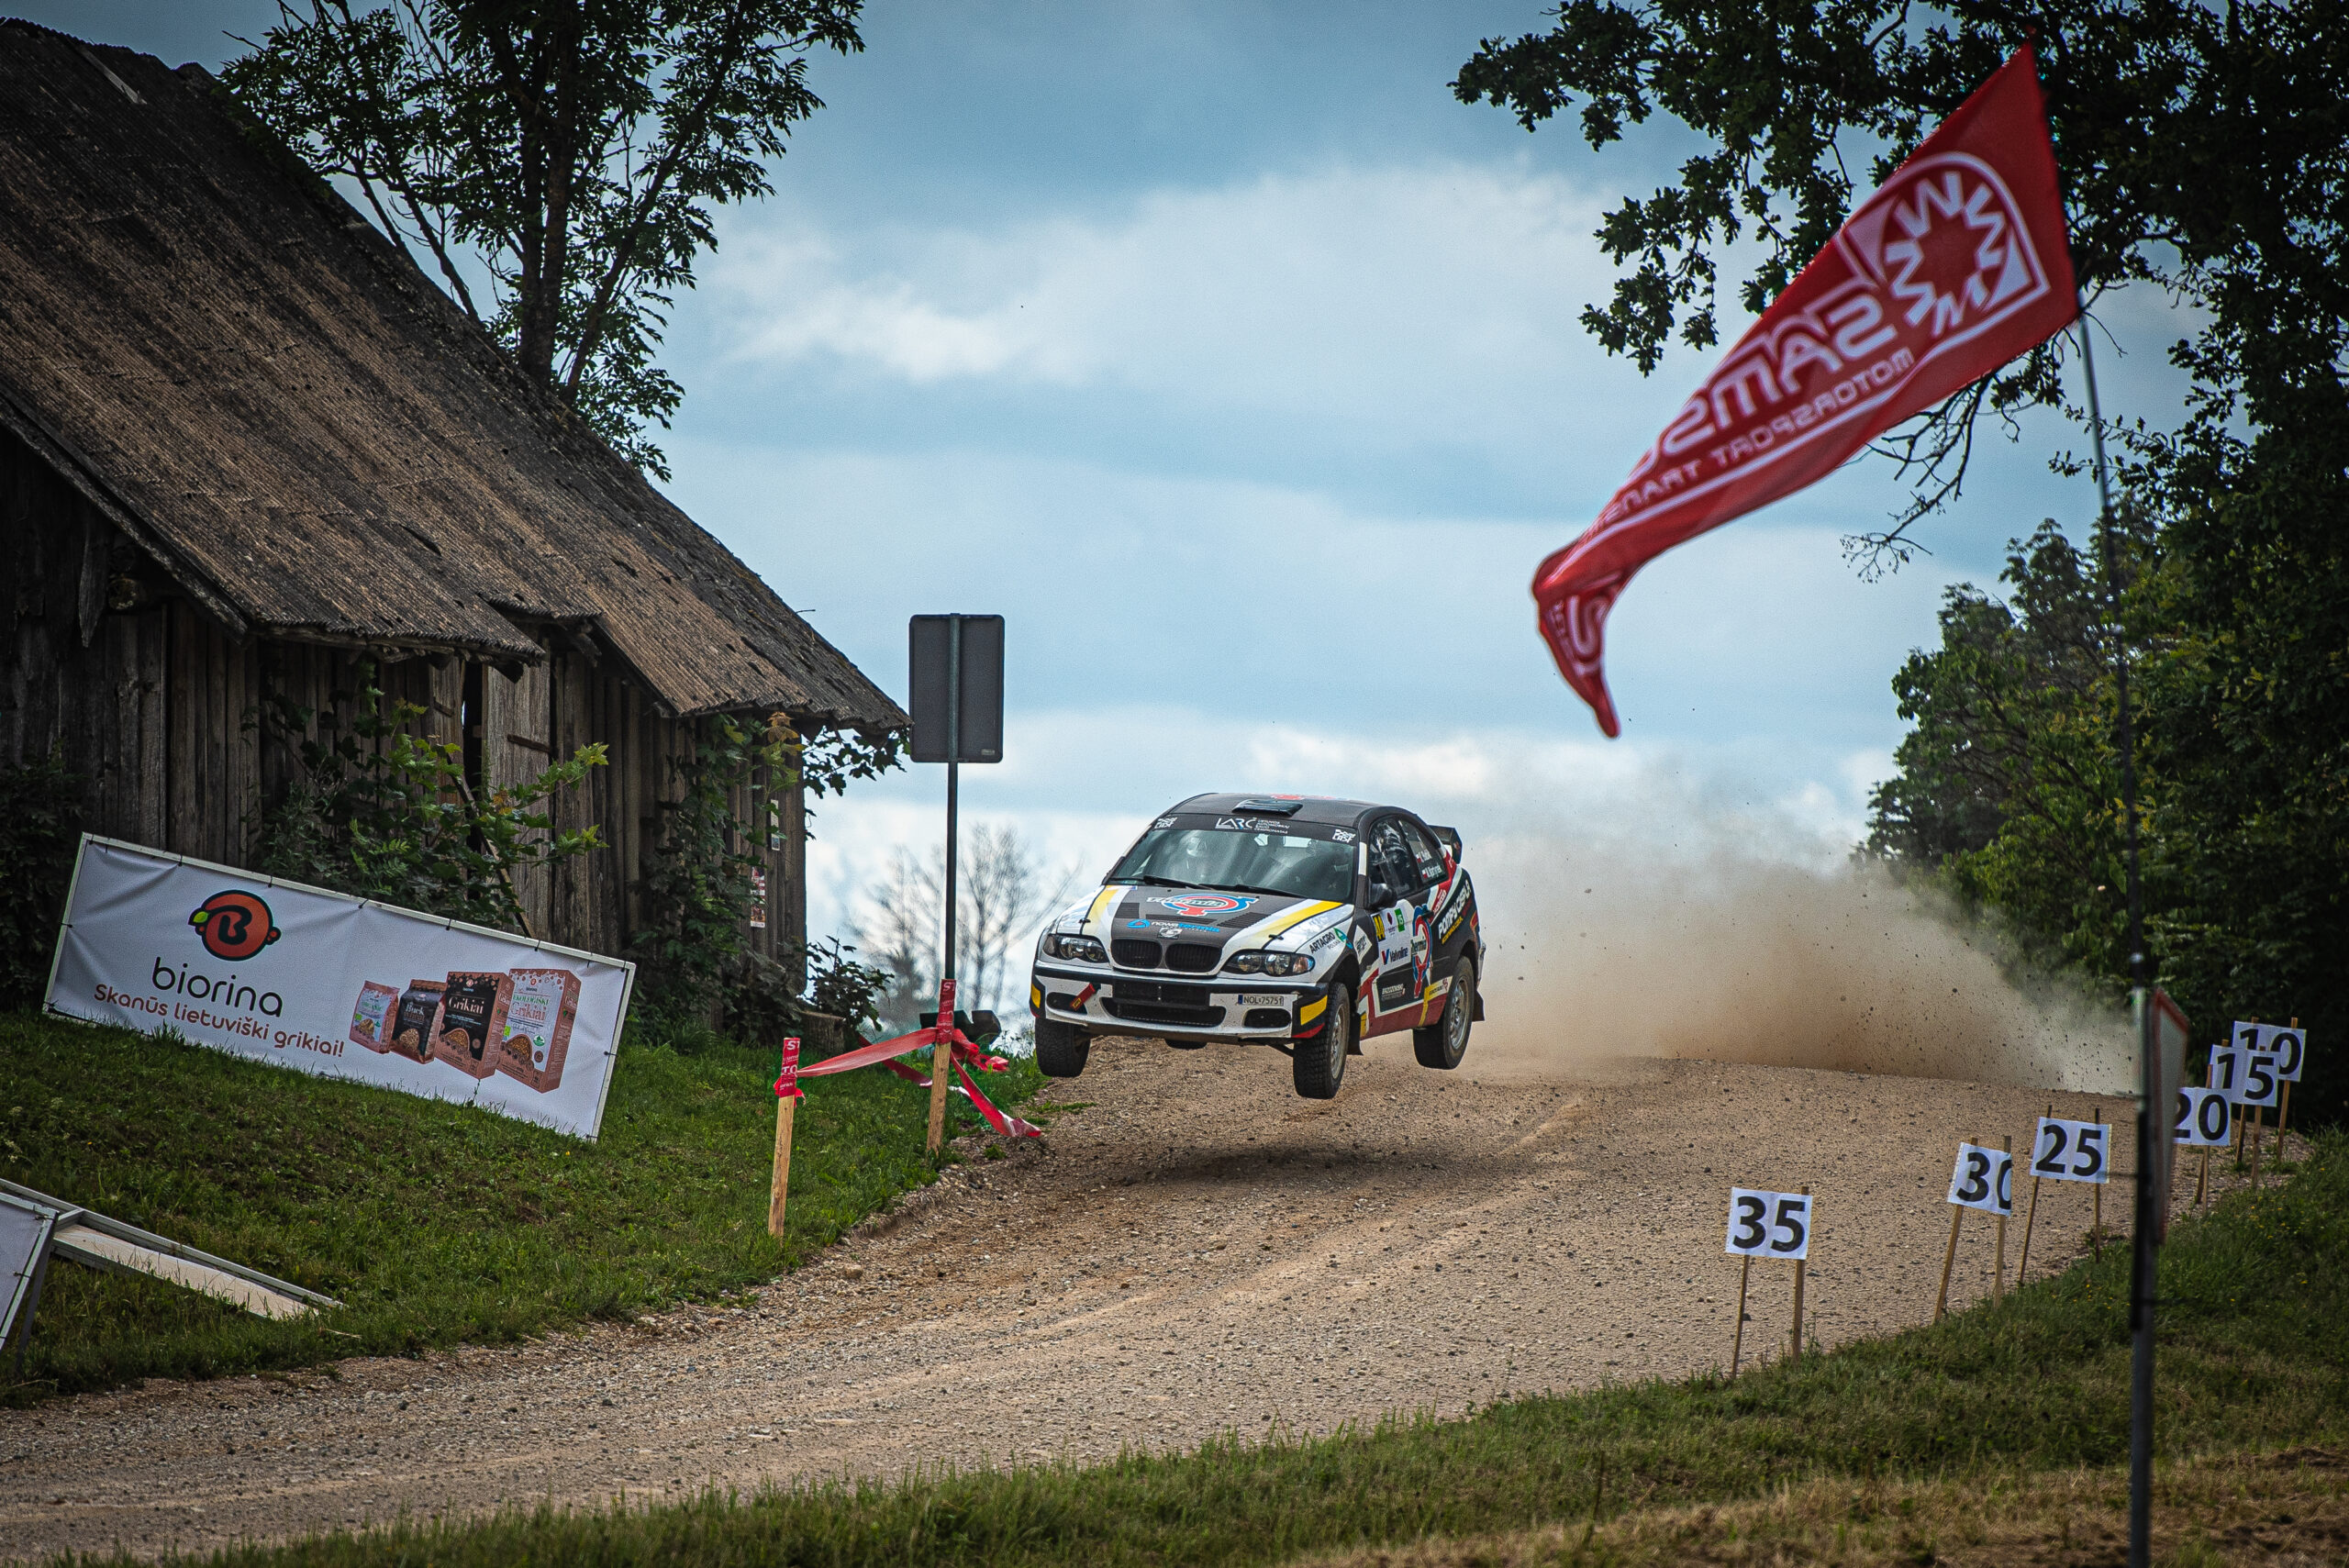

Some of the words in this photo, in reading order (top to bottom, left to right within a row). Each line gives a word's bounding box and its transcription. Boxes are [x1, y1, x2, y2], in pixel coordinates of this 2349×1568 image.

[1308, 930, 1336, 954] ARTAGRO
[1389, 945, 1408, 962] Valvoline
[151, 956, 284, 1018] biorina
[448, 995, 484, 1015] Grikiai
[1243, 995, 1259, 1005] NOL
[1261, 996, 1283, 1006] 75751
[94, 984, 169, 1017] Skanūs
[173, 1002, 270, 1040] lietuviški
[273, 1029, 345, 1058] grikiai!
[2216, 1052, 2275, 1100] 15
[2173, 1092, 2229, 1141] 20
[2035, 1123, 2102, 1178] 25
[1731, 1195, 1807, 1253] 35
